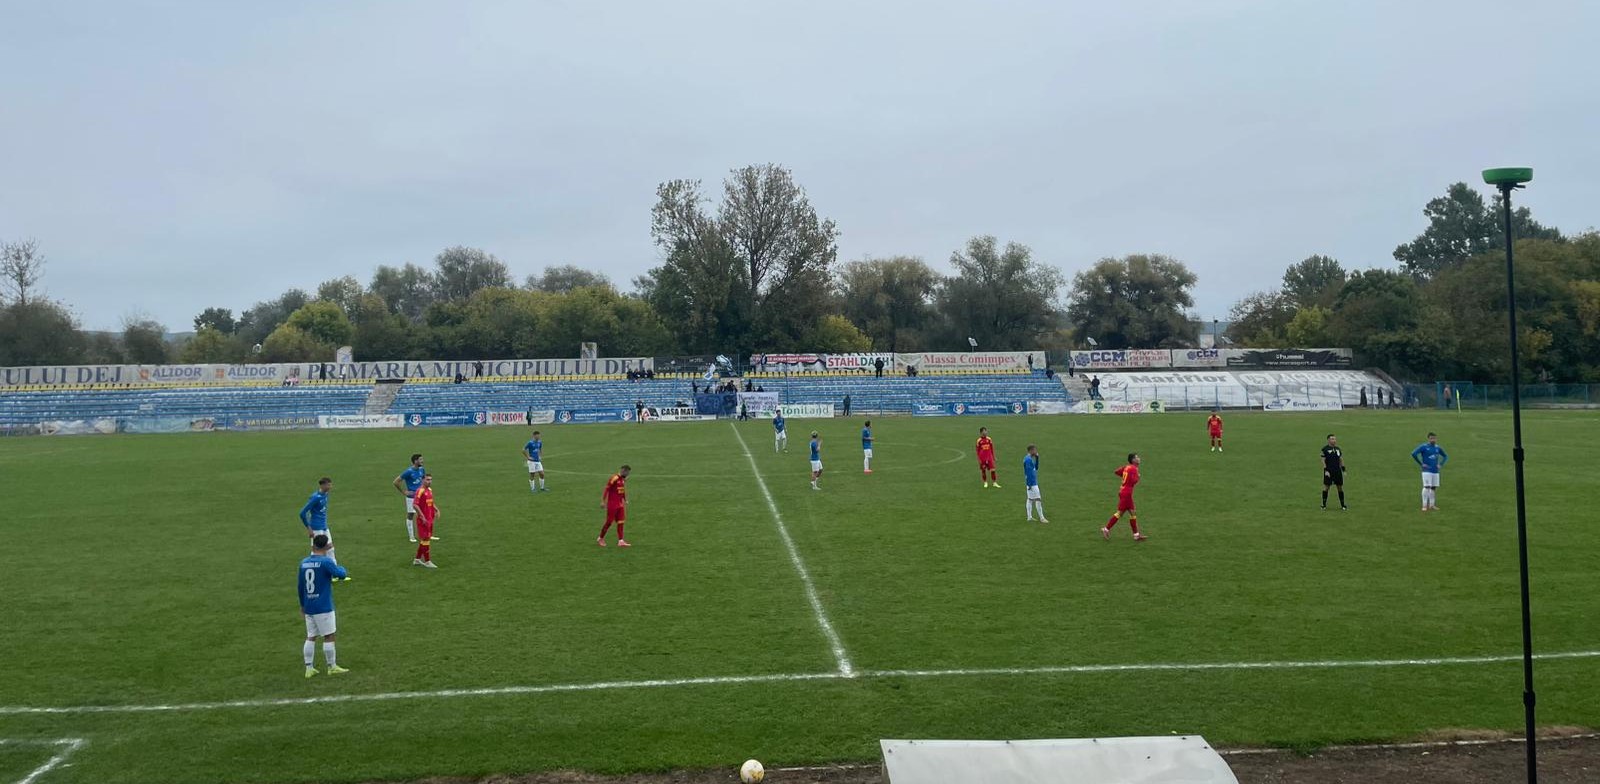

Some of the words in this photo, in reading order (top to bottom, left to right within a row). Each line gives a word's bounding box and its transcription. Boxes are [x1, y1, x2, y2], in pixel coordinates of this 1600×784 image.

[924, 354, 956, 364] Massa
[960, 354, 1016, 366] Comimpex
[1090, 351, 1126, 362] CCM
[0, 367, 67, 386] ULUI
[77, 366, 122, 384] DEJ
[152, 367, 202, 378] ALIDOR
[227, 366, 277, 377] ALIDOR
[1129, 373, 1227, 384] Mariflor
[782, 403, 829, 417] ToniLand
[1293, 401, 1318, 409] Energy
[661, 408, 679, 416] CASA
[279, 416, 316, 425] SECURITY
[305, 568, 315, 594] 8
